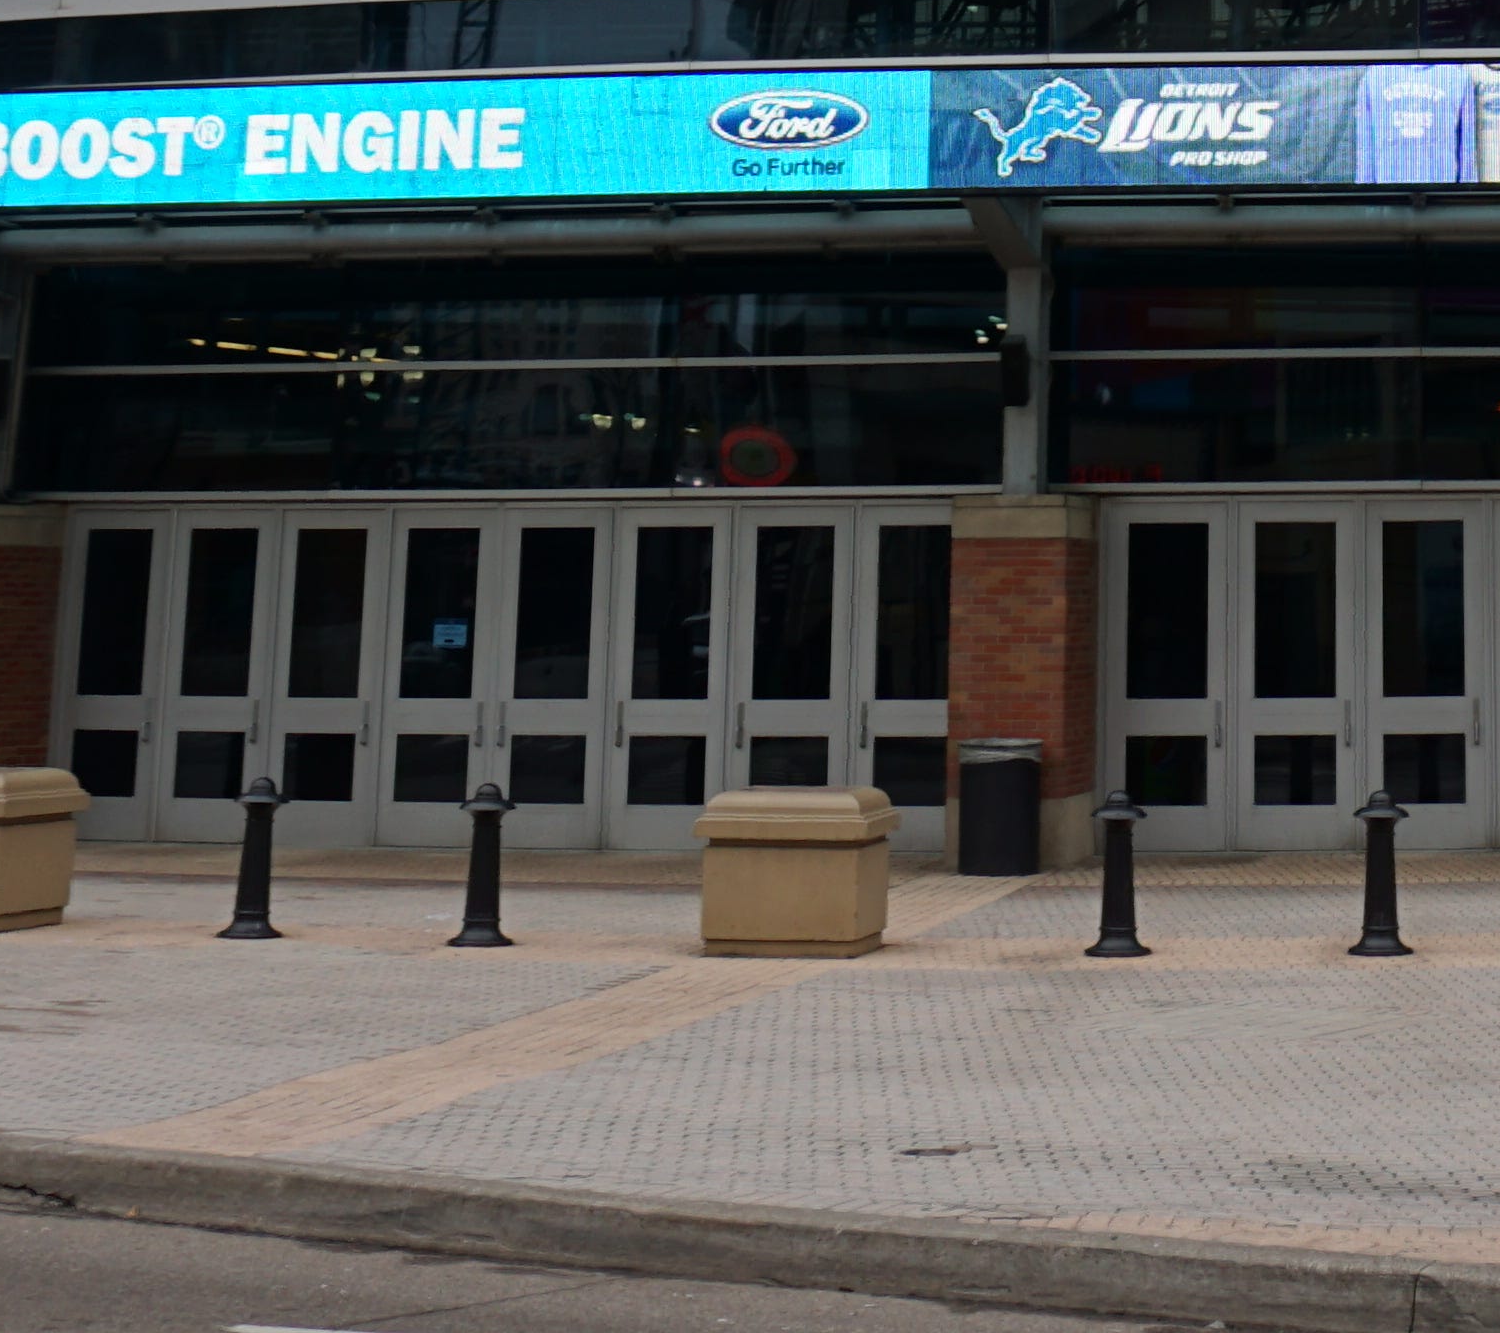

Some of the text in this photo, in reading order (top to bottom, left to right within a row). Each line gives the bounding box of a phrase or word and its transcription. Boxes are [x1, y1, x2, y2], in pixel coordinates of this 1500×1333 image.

[1159, 82, 1240, 99] DETROIT
[738, 97, 839, 140] Ford
[1097, 98, 1281, 152] LIONS
[244, 106, 527, 176] ENGINE
[731, 156, 847, 177] Go Further
[1169, 150, 1269, 168] PRO SHOP
